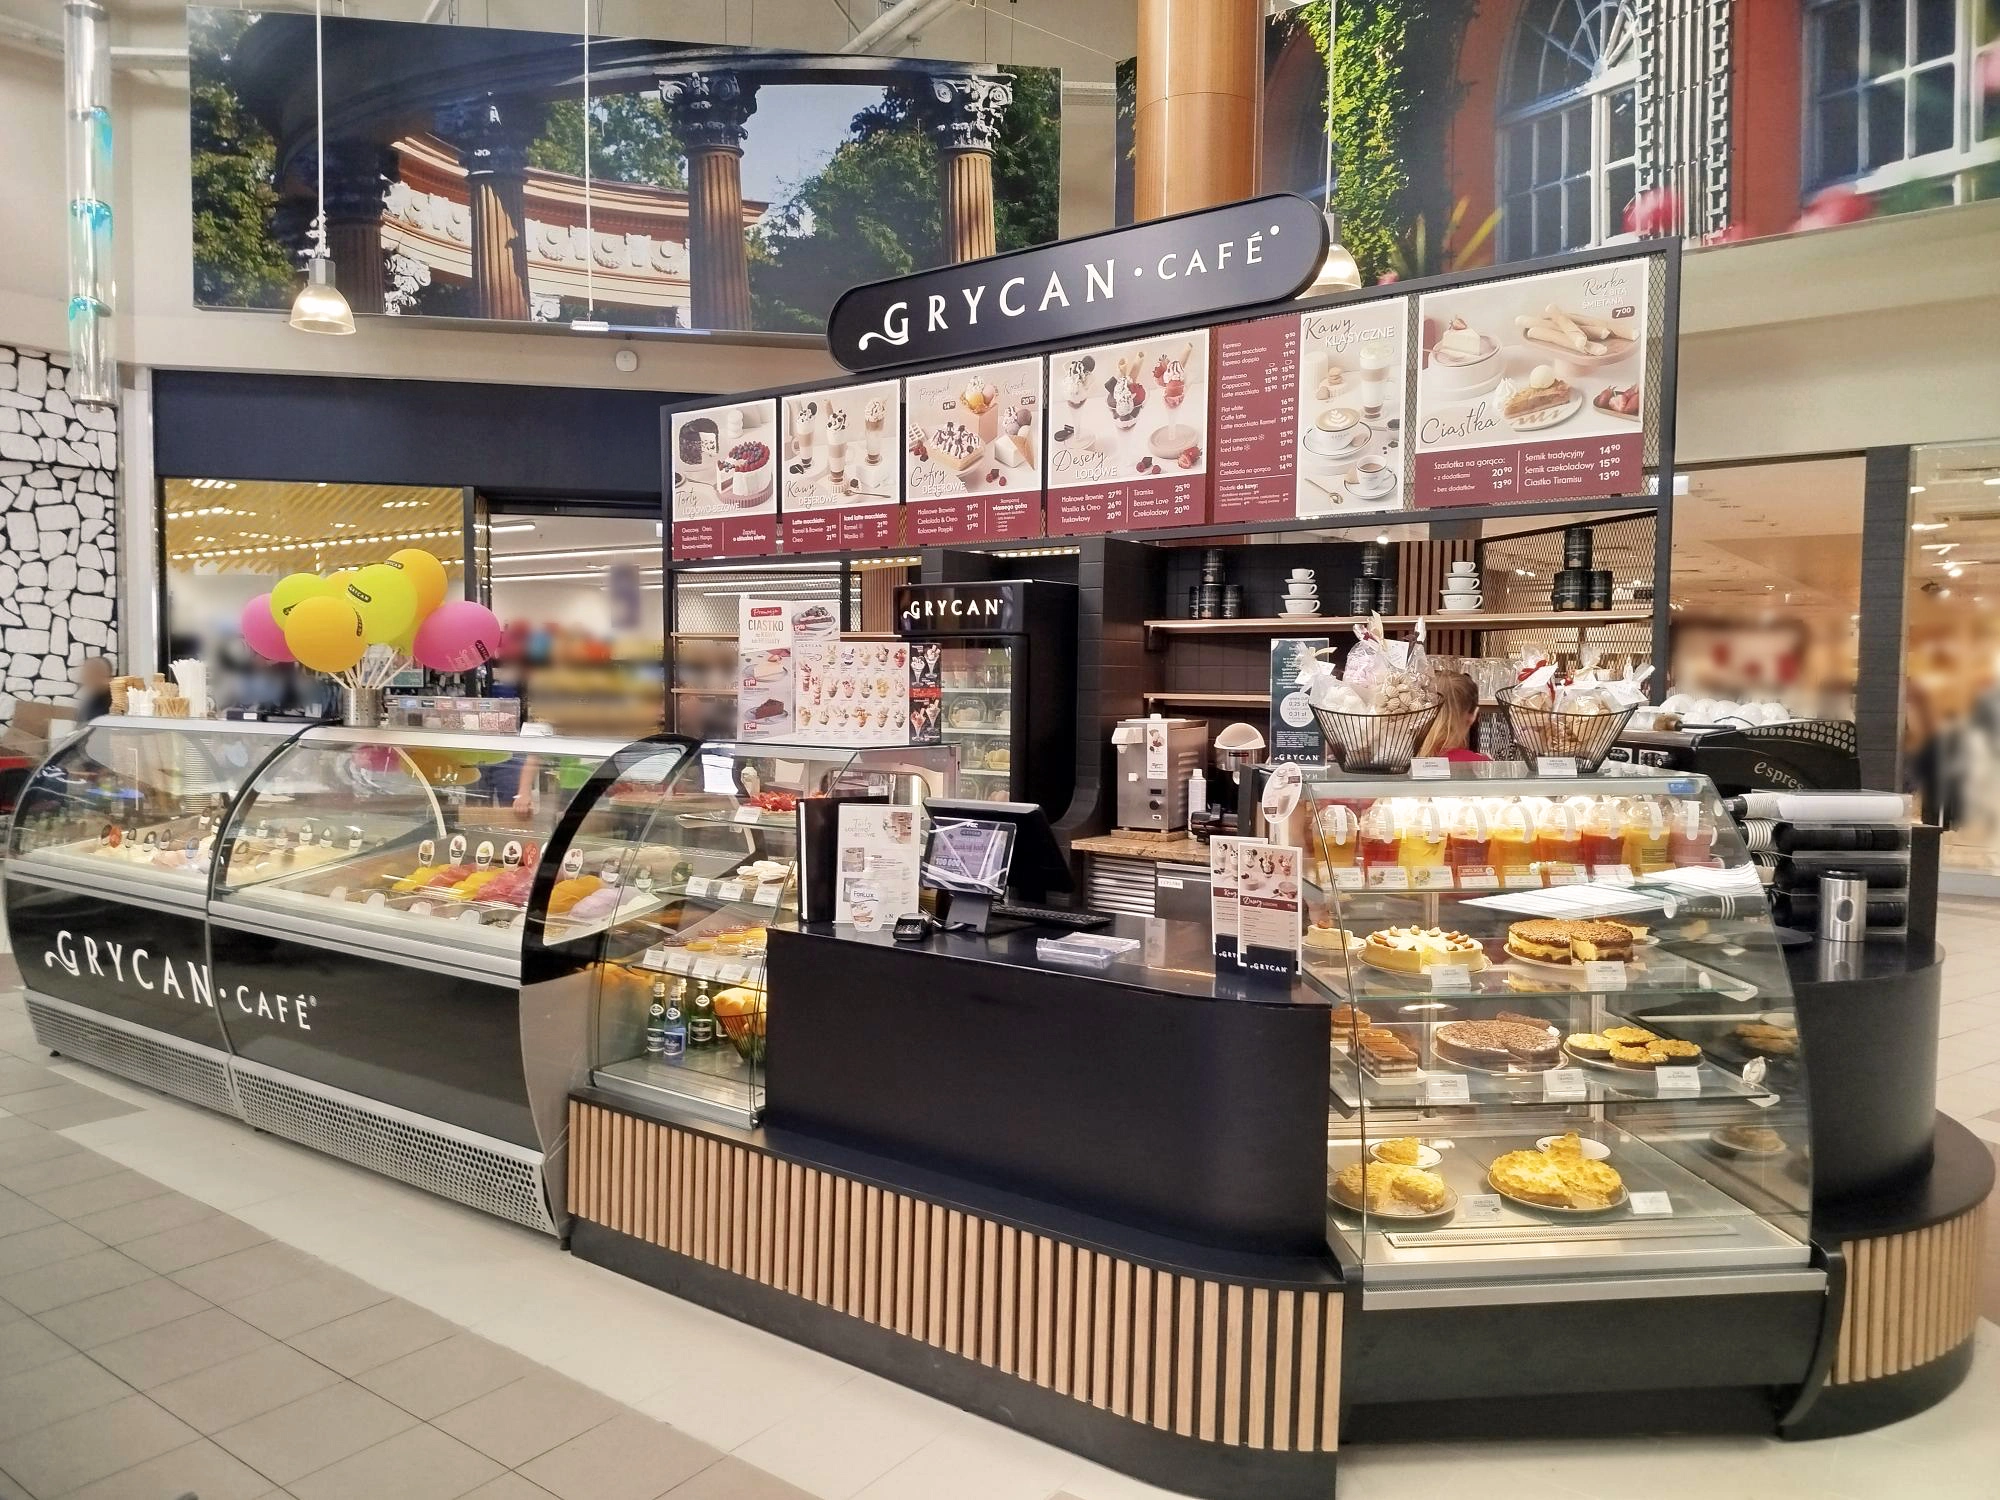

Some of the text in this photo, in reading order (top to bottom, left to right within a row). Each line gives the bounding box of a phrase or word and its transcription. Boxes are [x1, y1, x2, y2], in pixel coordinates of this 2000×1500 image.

[858, 258, 1115, 350] GRYCAN
[1303, 318, 1353, 352] Kawy
[1326, 325, 1395, 347] KLASYCZNE
[1421, 402, 1500, 444] Ciastka
[1053, 450, 1106, 478] Desery
[1434, 461, 1464, 470] Szarlotka
[1477, 457, 1506, 467] gorąco:
[1525, 453, 1546, 461] Sernik
[1547, 449, 1585, 459] tradycyjny
[1441, 472, 1471, 480] dodatkami
[1525, 465, 1545, 474] Sernik
[1546, 462, 1595, 472] czekoladowy
[1524, 478, 1551, 487] Ciastko
[1553, 476, 1582, 485] Tiramisu
[786, 481, 816, 505] Kawy
[1133, 510, 1169, 518] Czekoladowy
[903, 599, 999, 620] GRYCAN
[748, 620, 784, 631] CIASTKO
[45, 930, 214, 1008] GRYCAN
